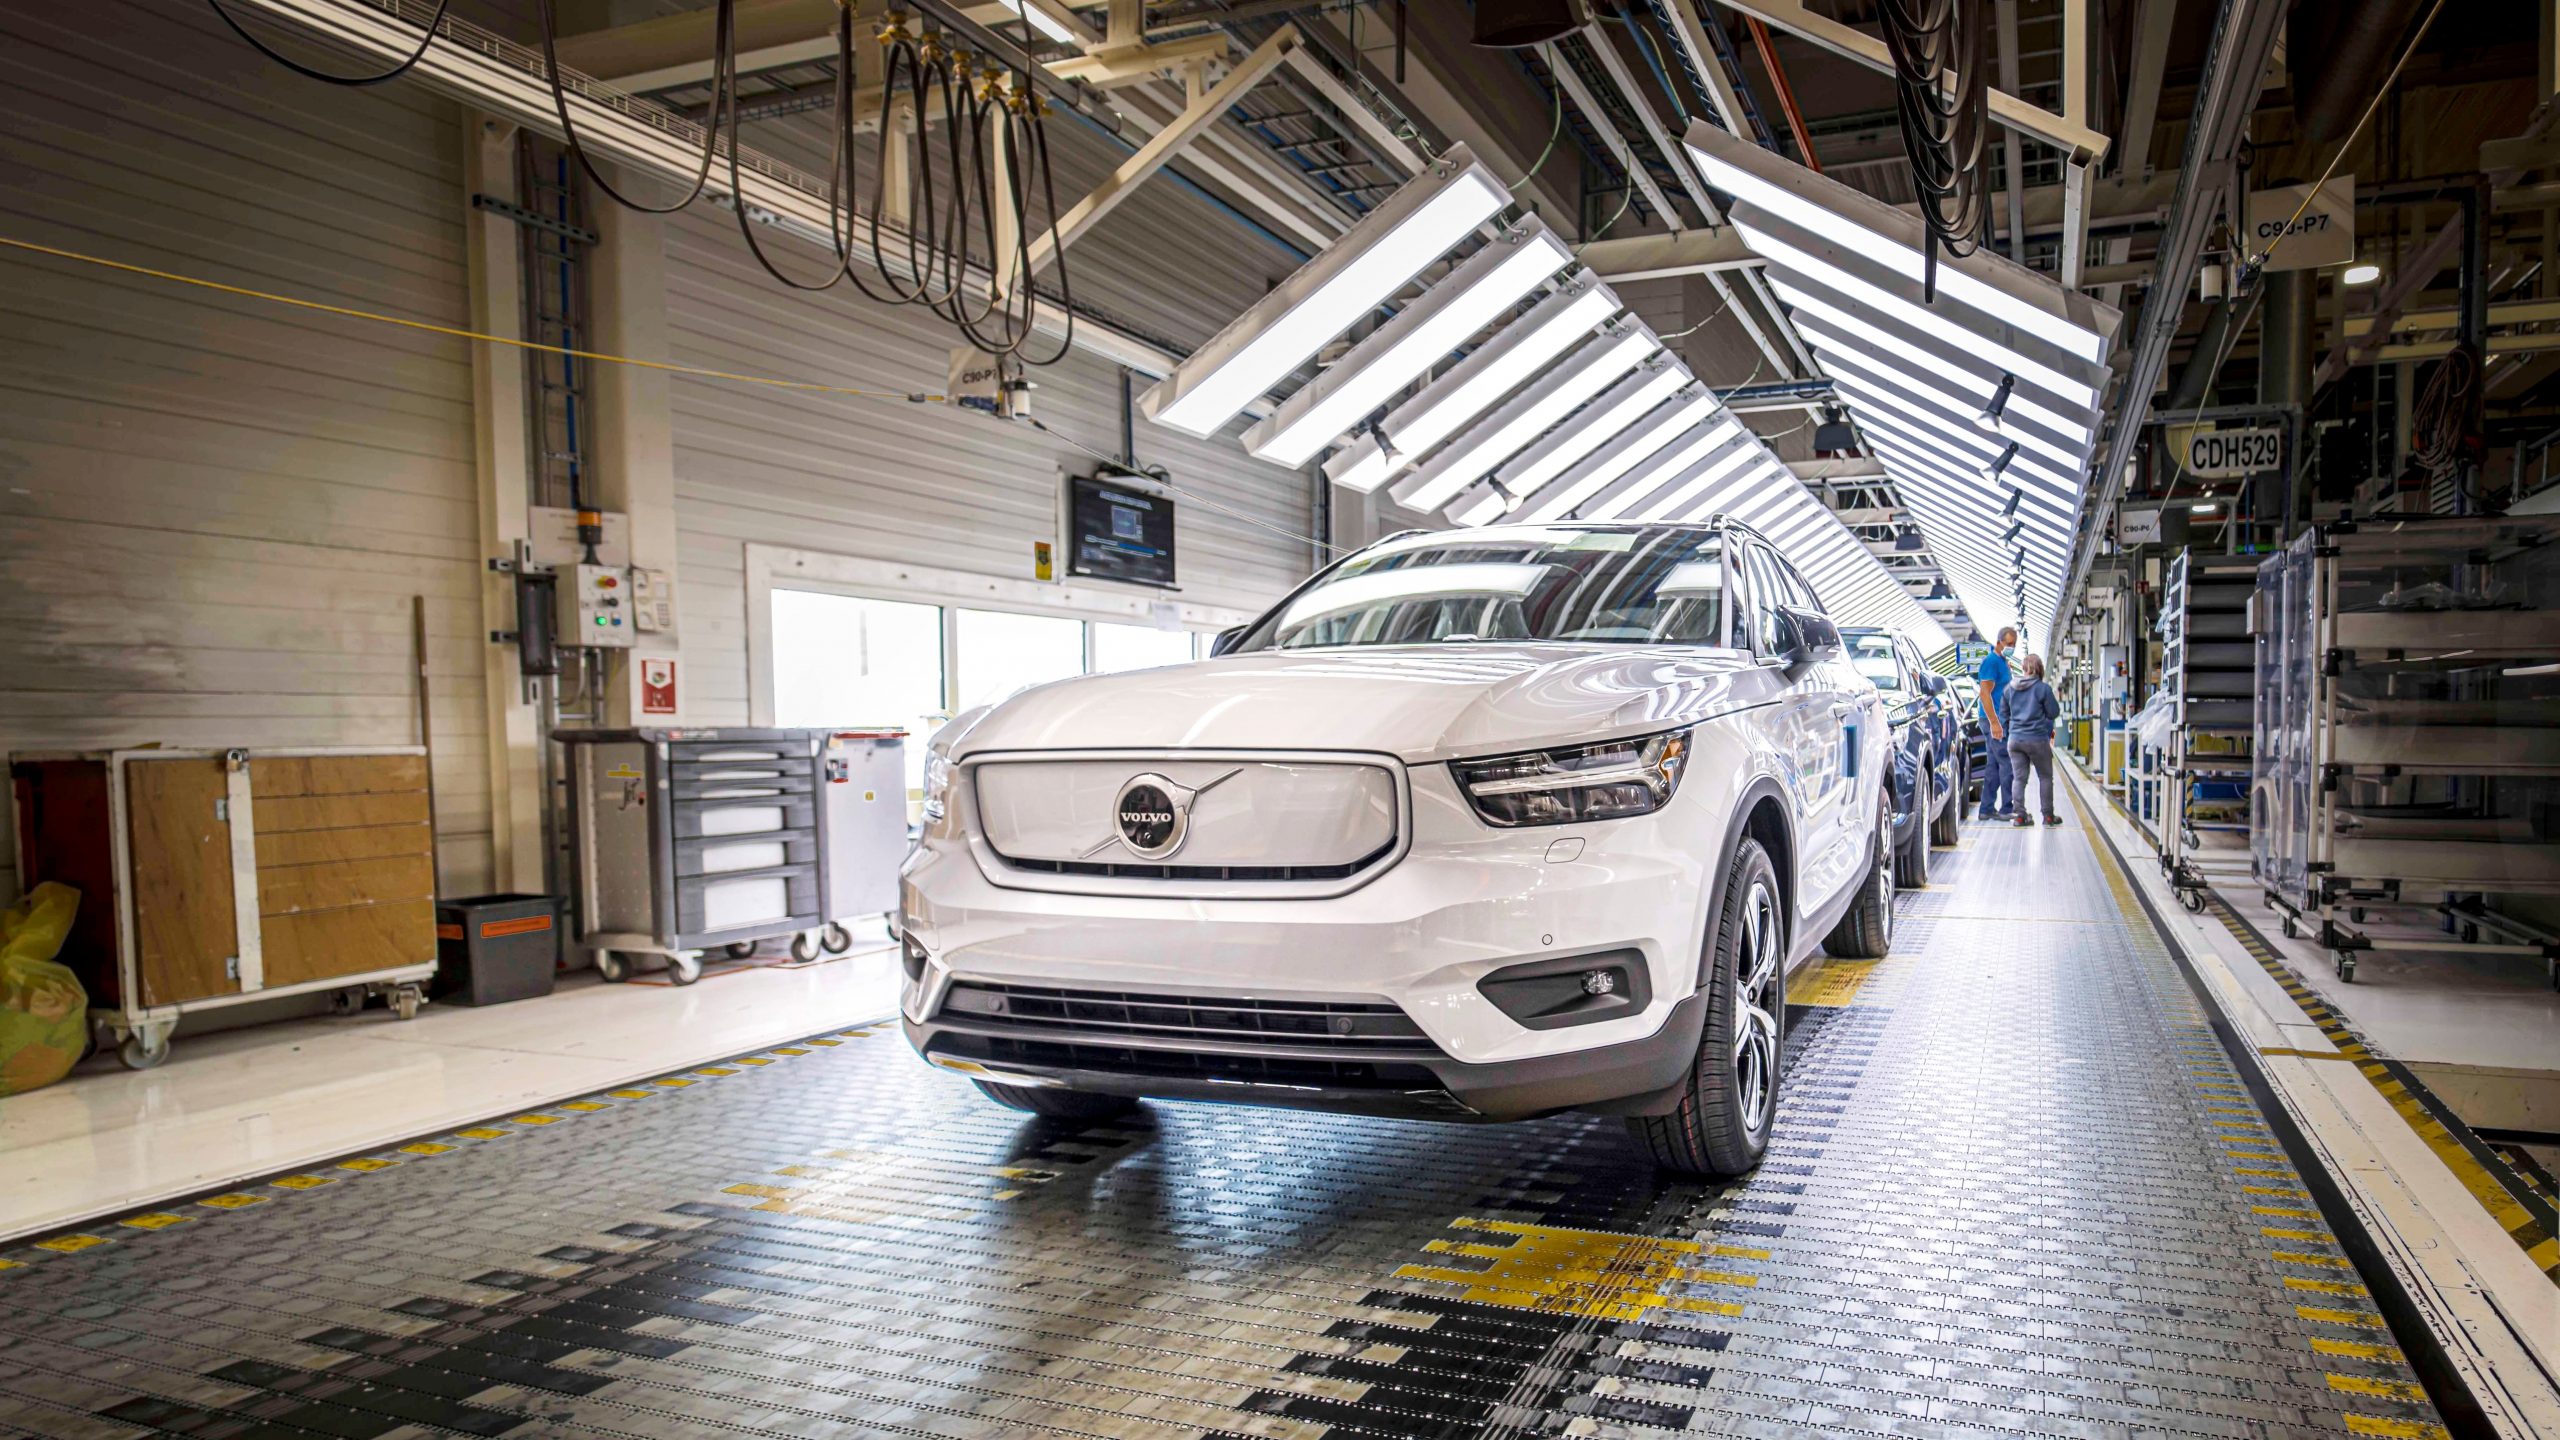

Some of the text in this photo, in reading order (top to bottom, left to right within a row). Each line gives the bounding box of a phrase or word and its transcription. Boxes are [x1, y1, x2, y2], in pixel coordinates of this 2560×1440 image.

[2258, 214, 2329, 238] C90-P7
[2192, 434, 2278, 470] CDH529
[1121, 812, 1172, 822] VOLVO
